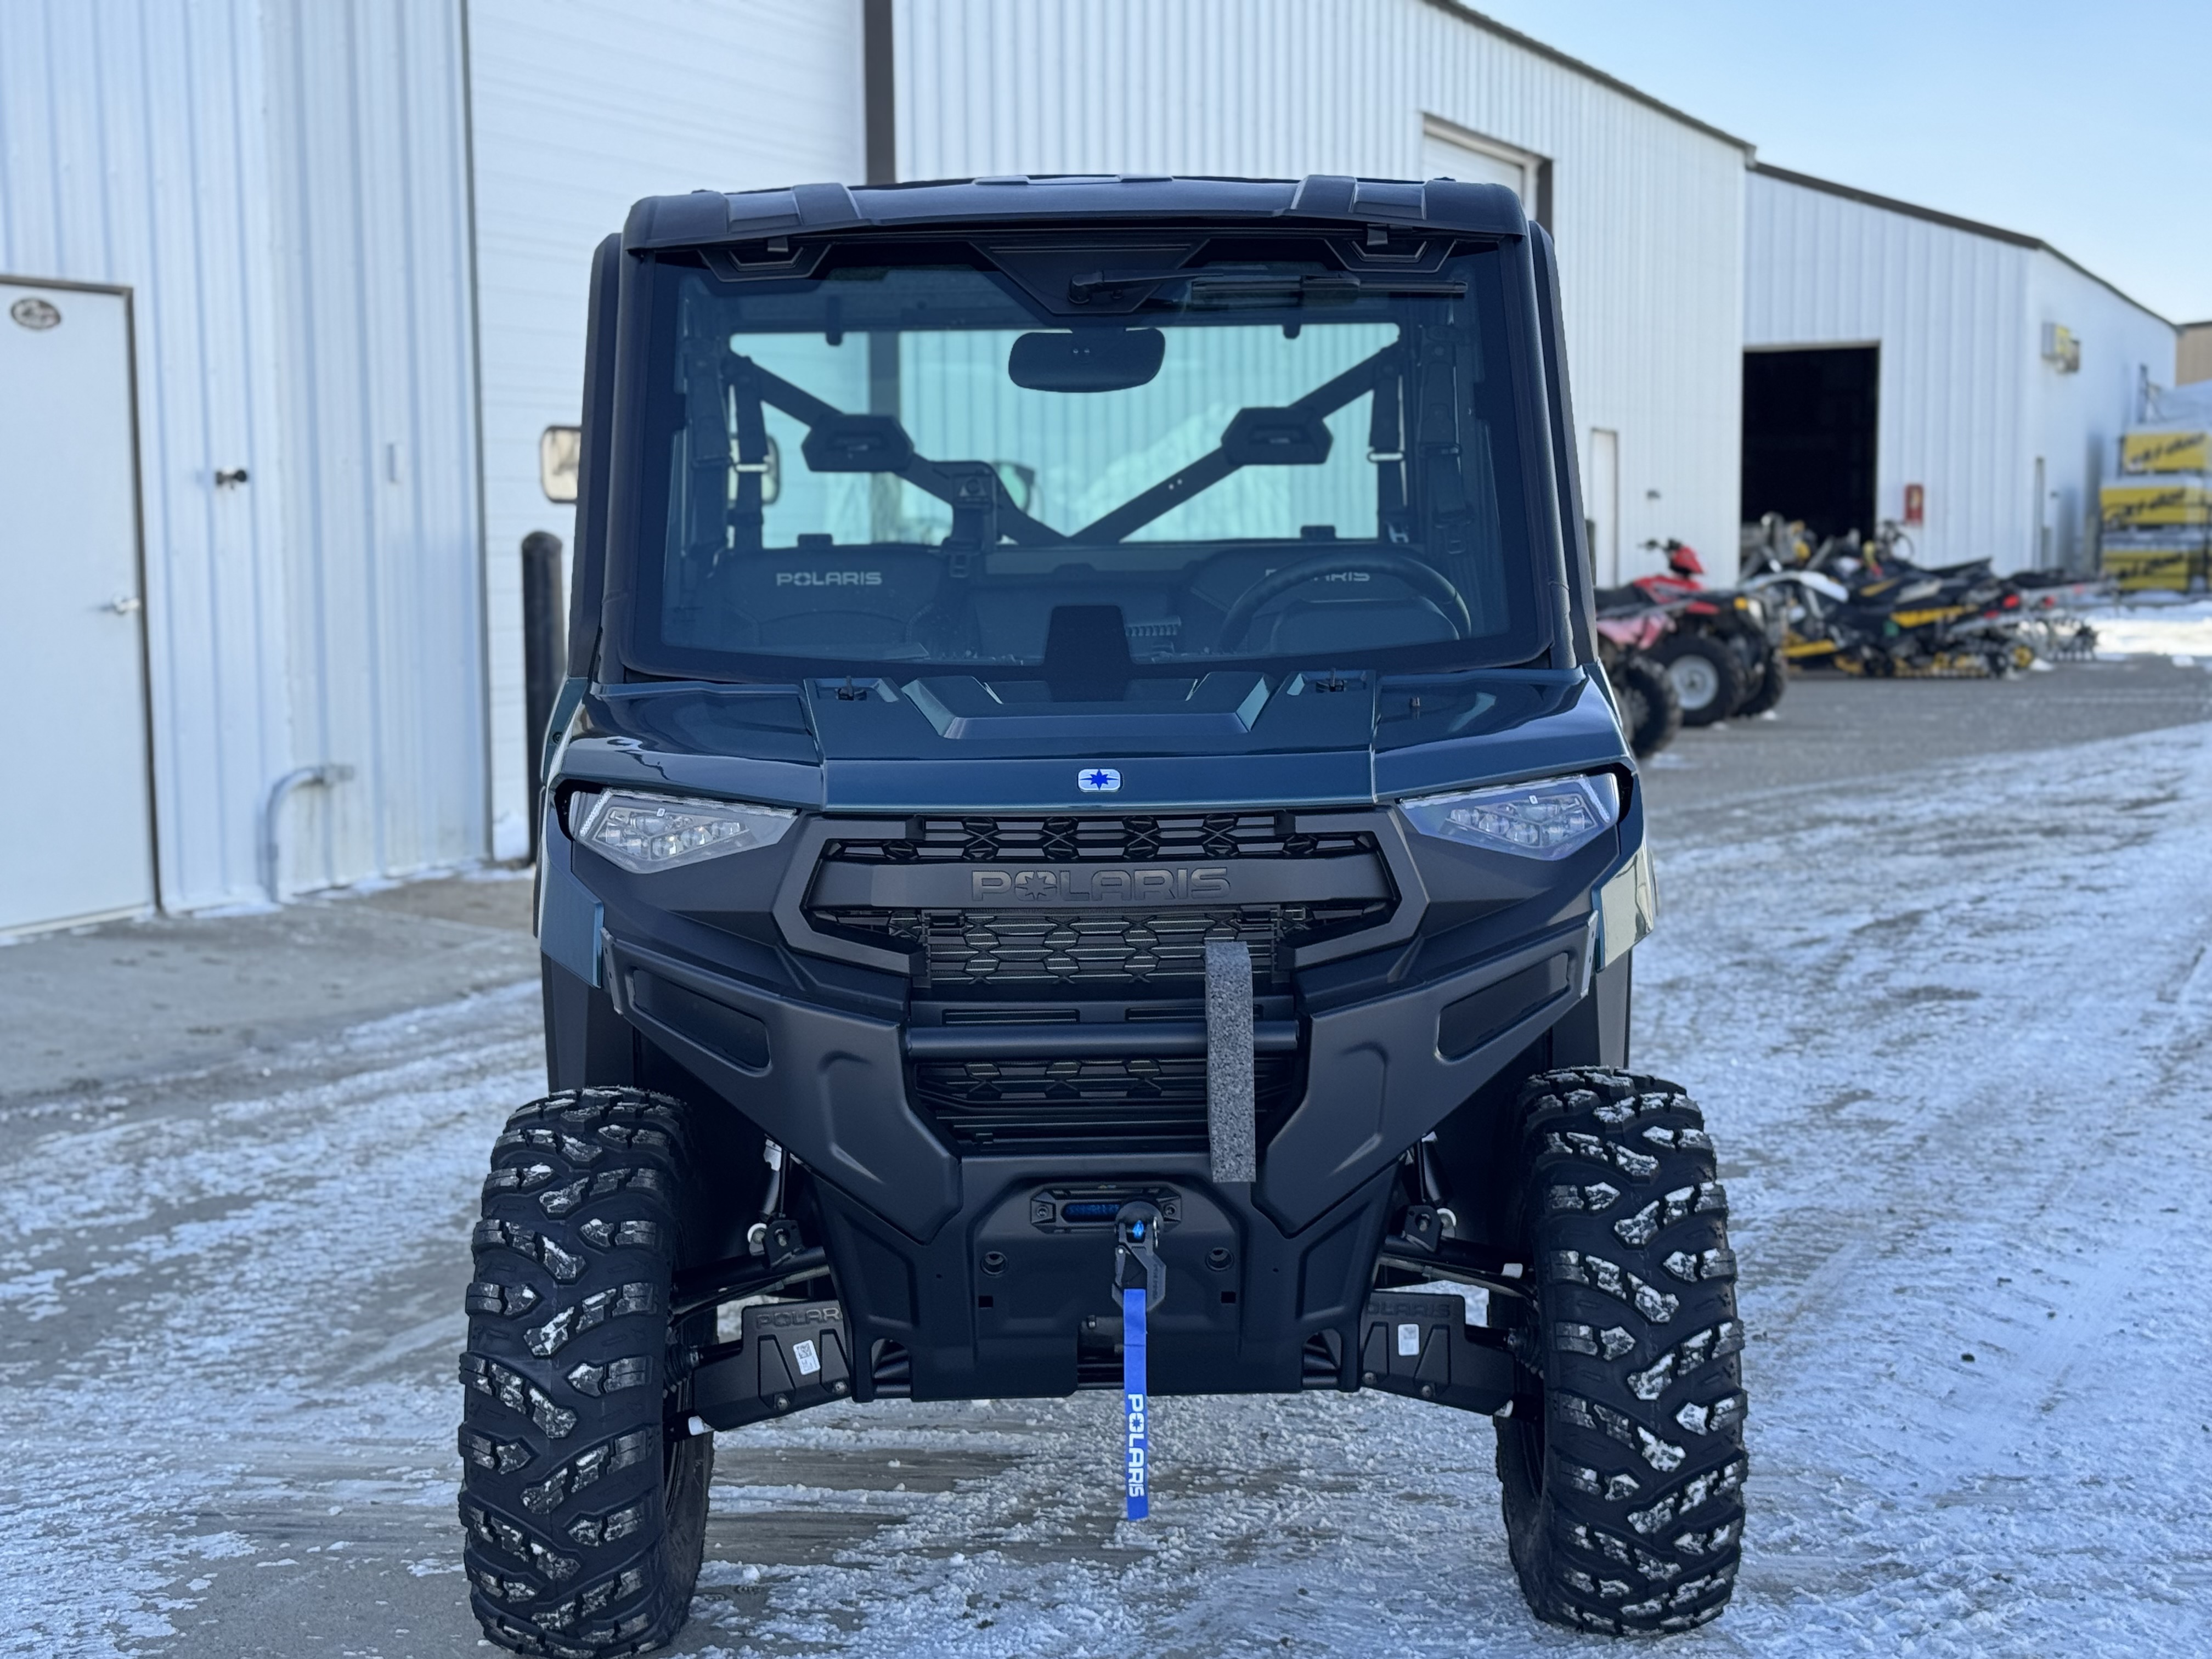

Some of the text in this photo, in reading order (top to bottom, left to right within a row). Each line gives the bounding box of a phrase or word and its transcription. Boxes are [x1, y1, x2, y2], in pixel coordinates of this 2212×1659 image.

[776, 572, 882, 586] POLARIS
[972, 867, 1231, 901] POLARIS
[757, 1308, 841, 1329] POLAR
[1128, 1394, 1144, 1497] POLARIS
